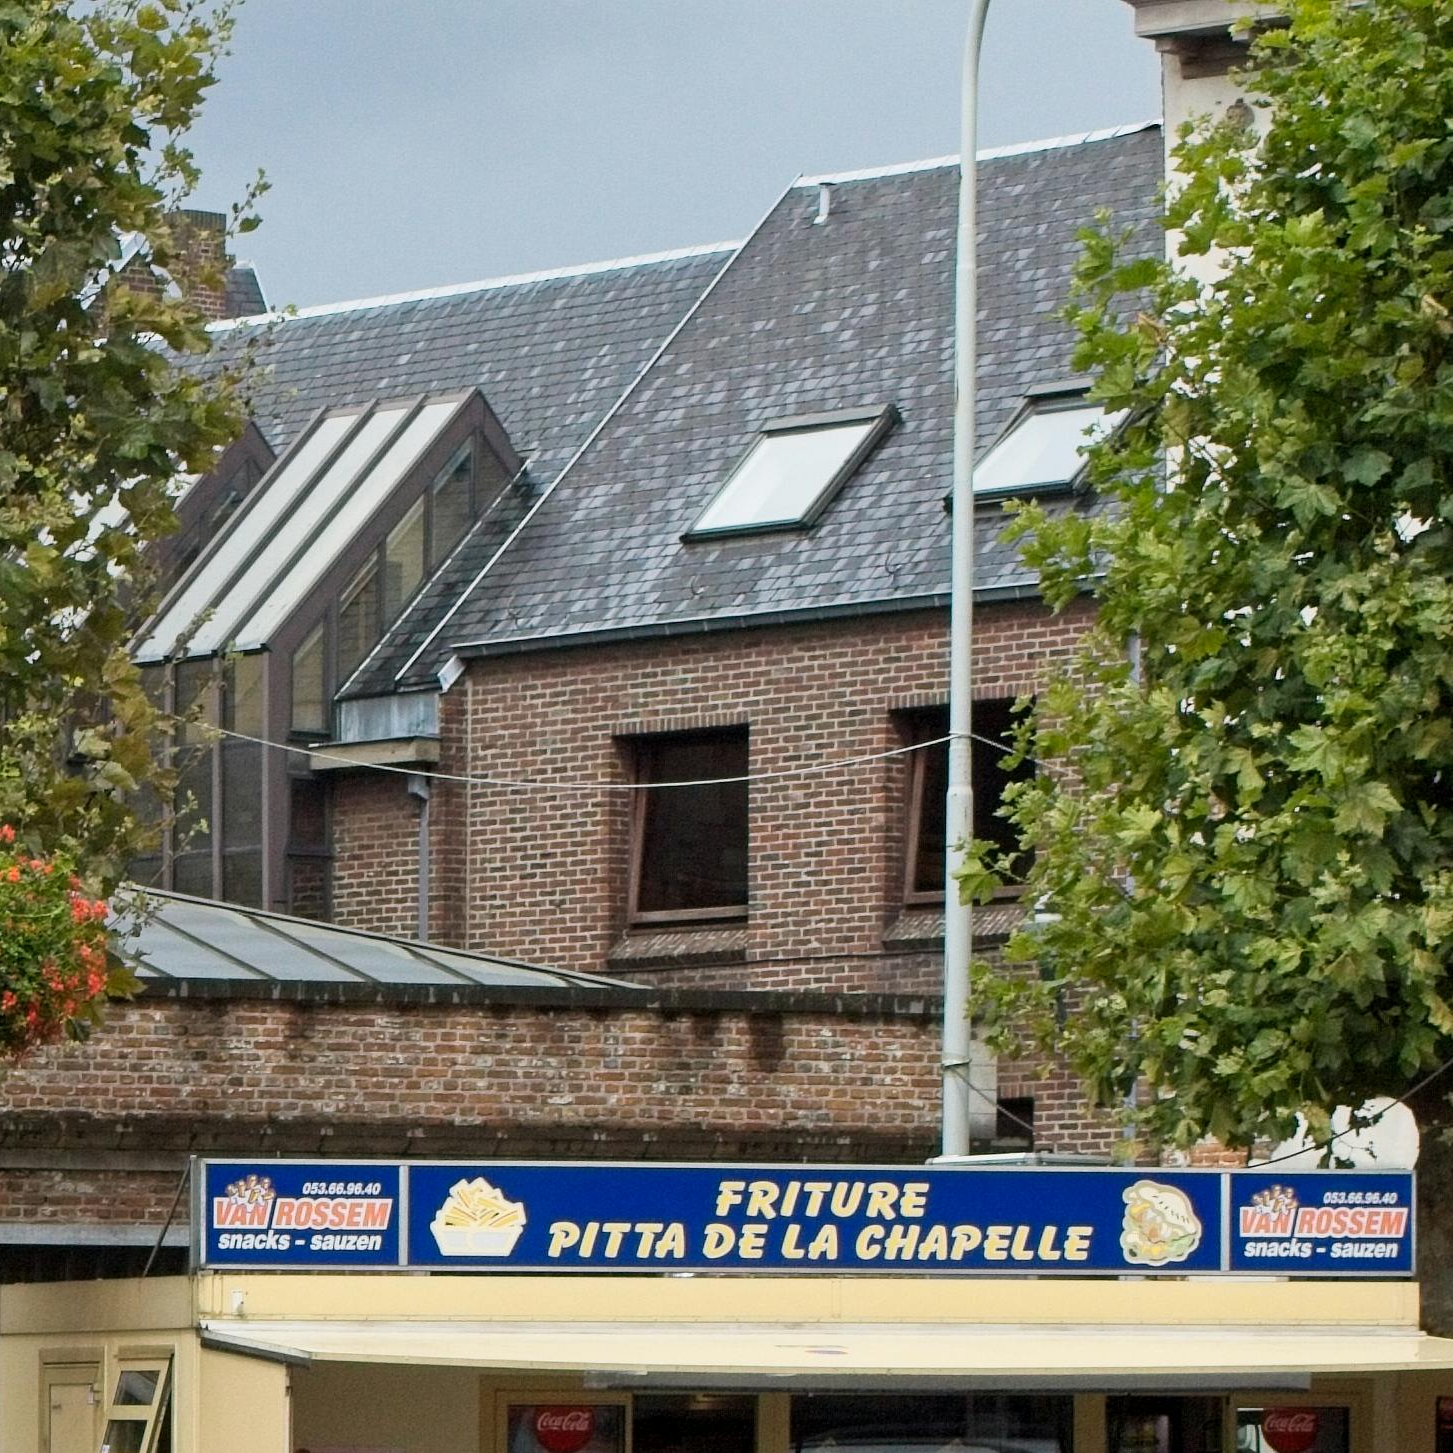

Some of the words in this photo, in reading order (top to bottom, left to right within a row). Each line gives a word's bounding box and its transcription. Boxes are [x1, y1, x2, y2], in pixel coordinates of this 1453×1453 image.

[302, 1182, 382, 1196] 053.66.96.40
[716, 1180, 931, 1219] FRITURE
[1323, 1191, 1398, 1204] 053.66.96.40
[215, 1200, 269, 1227] VAN
[274, 1200, 390, 1227] ROSSEM
[1242, 1209, 1290, 1235] VAN
[1297, 1209, 1405, 1235] ROSSEM
[217, 1230, 291, 1251] snacks
[309, 1233, 382, 1251] sauzen
[548, 1221, 686, 1259] PITTA
[701, 1222, 766, 1260] DE
[781, 1223, 839, 1261] LA
[855, 1223, 1094, 1262] CHAPELLE
[1244, 1238, 1313, 1258] snacks
[1330, 1242, 1399, 1258] sauzen
